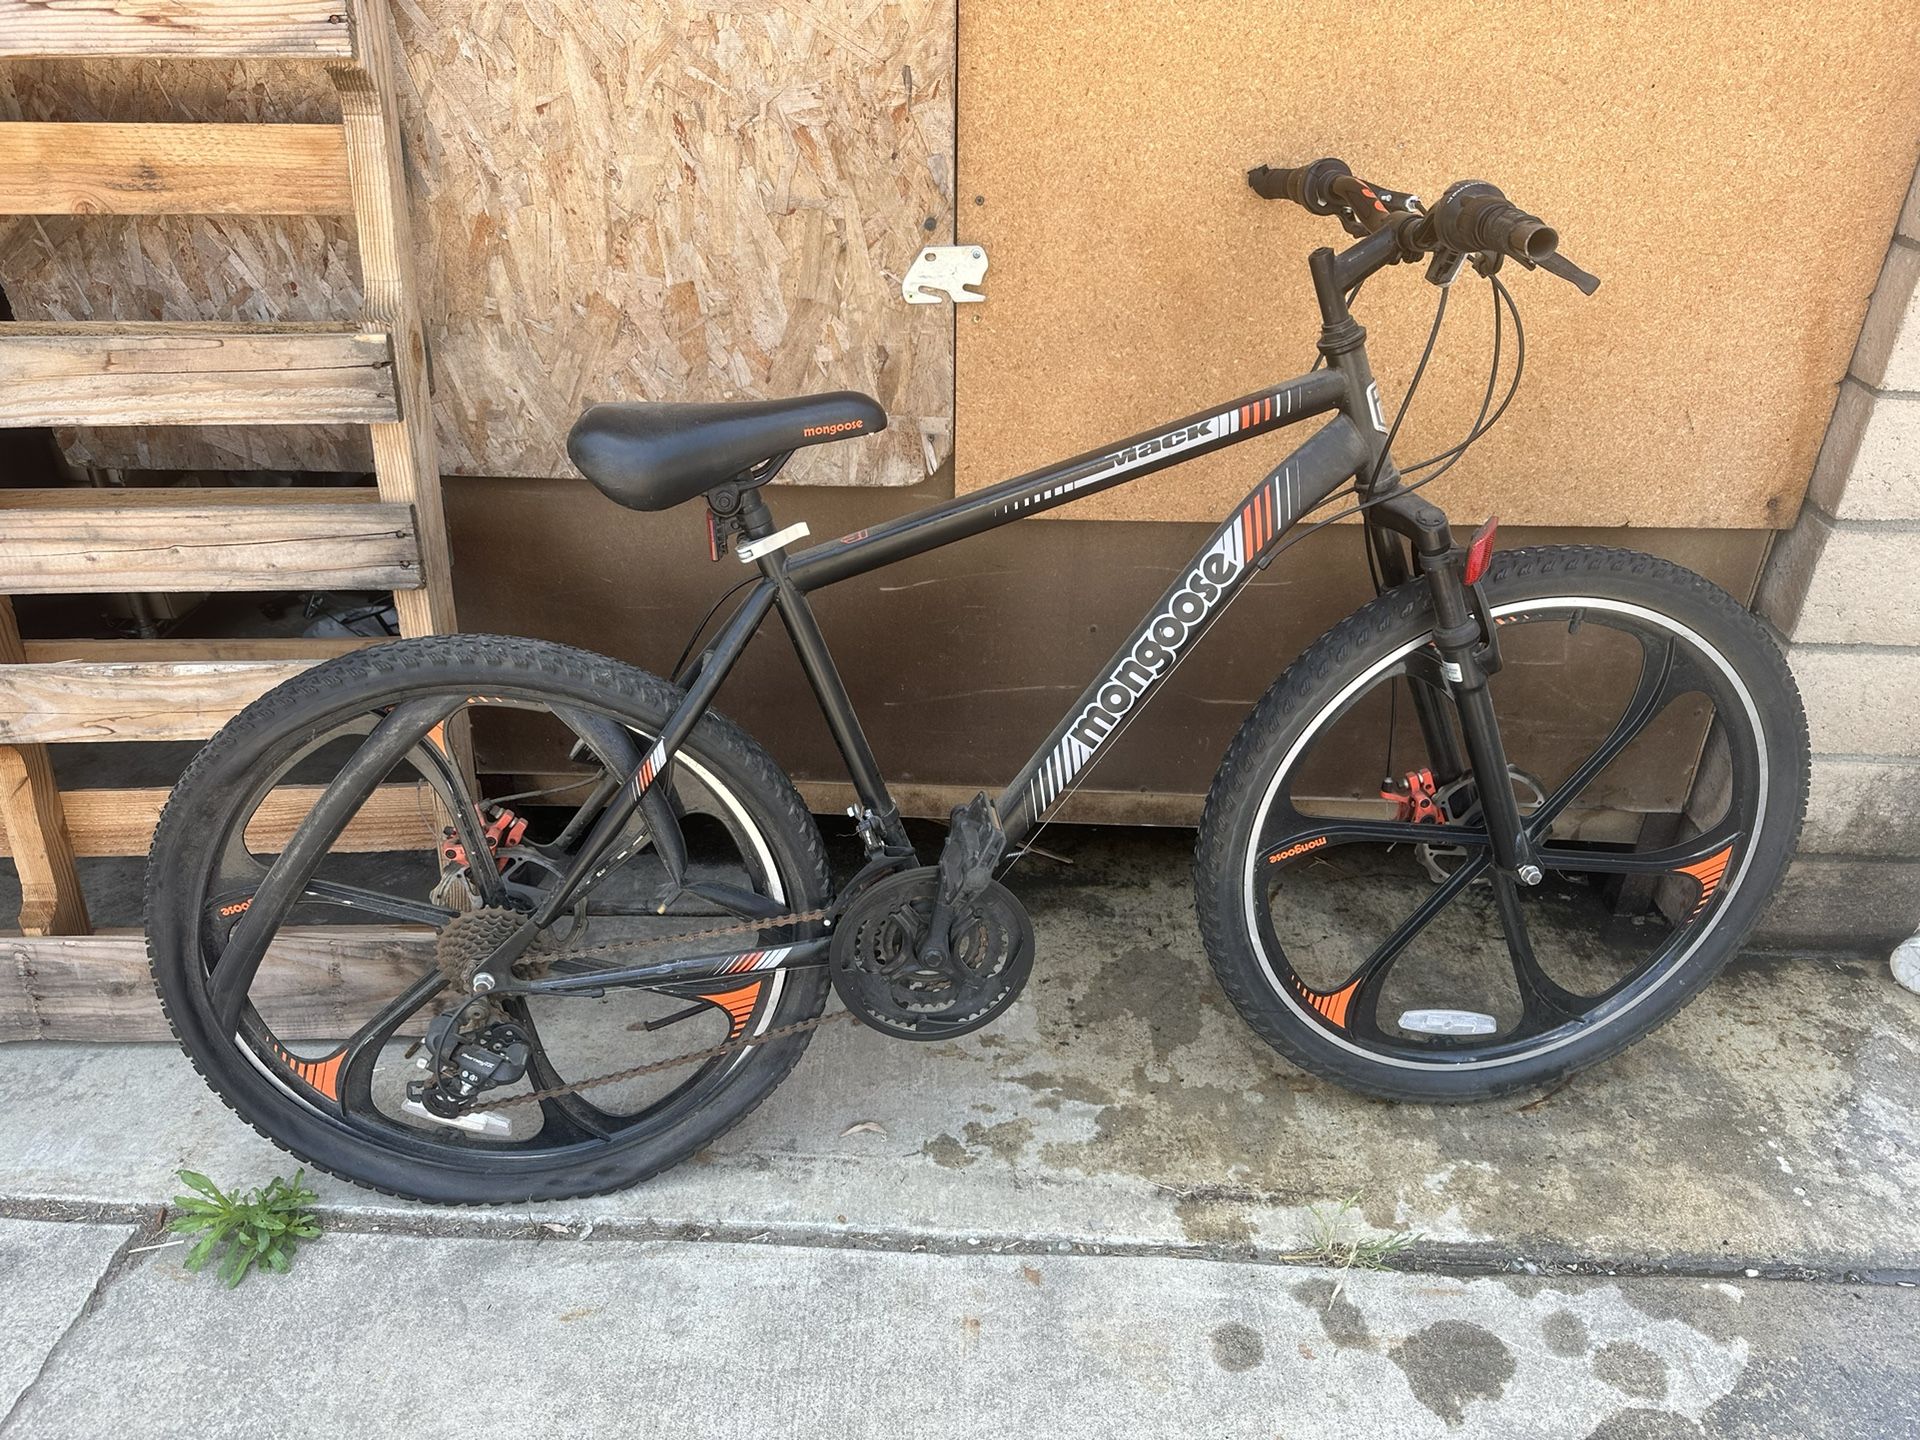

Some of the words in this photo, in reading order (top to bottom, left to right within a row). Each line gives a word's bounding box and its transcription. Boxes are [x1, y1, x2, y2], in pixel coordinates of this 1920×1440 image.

[803, 419, 863, 437] mongoose
[1069, 552, 1238, 749] mongoose
[1269, 836, 1327, 864] mongoose
